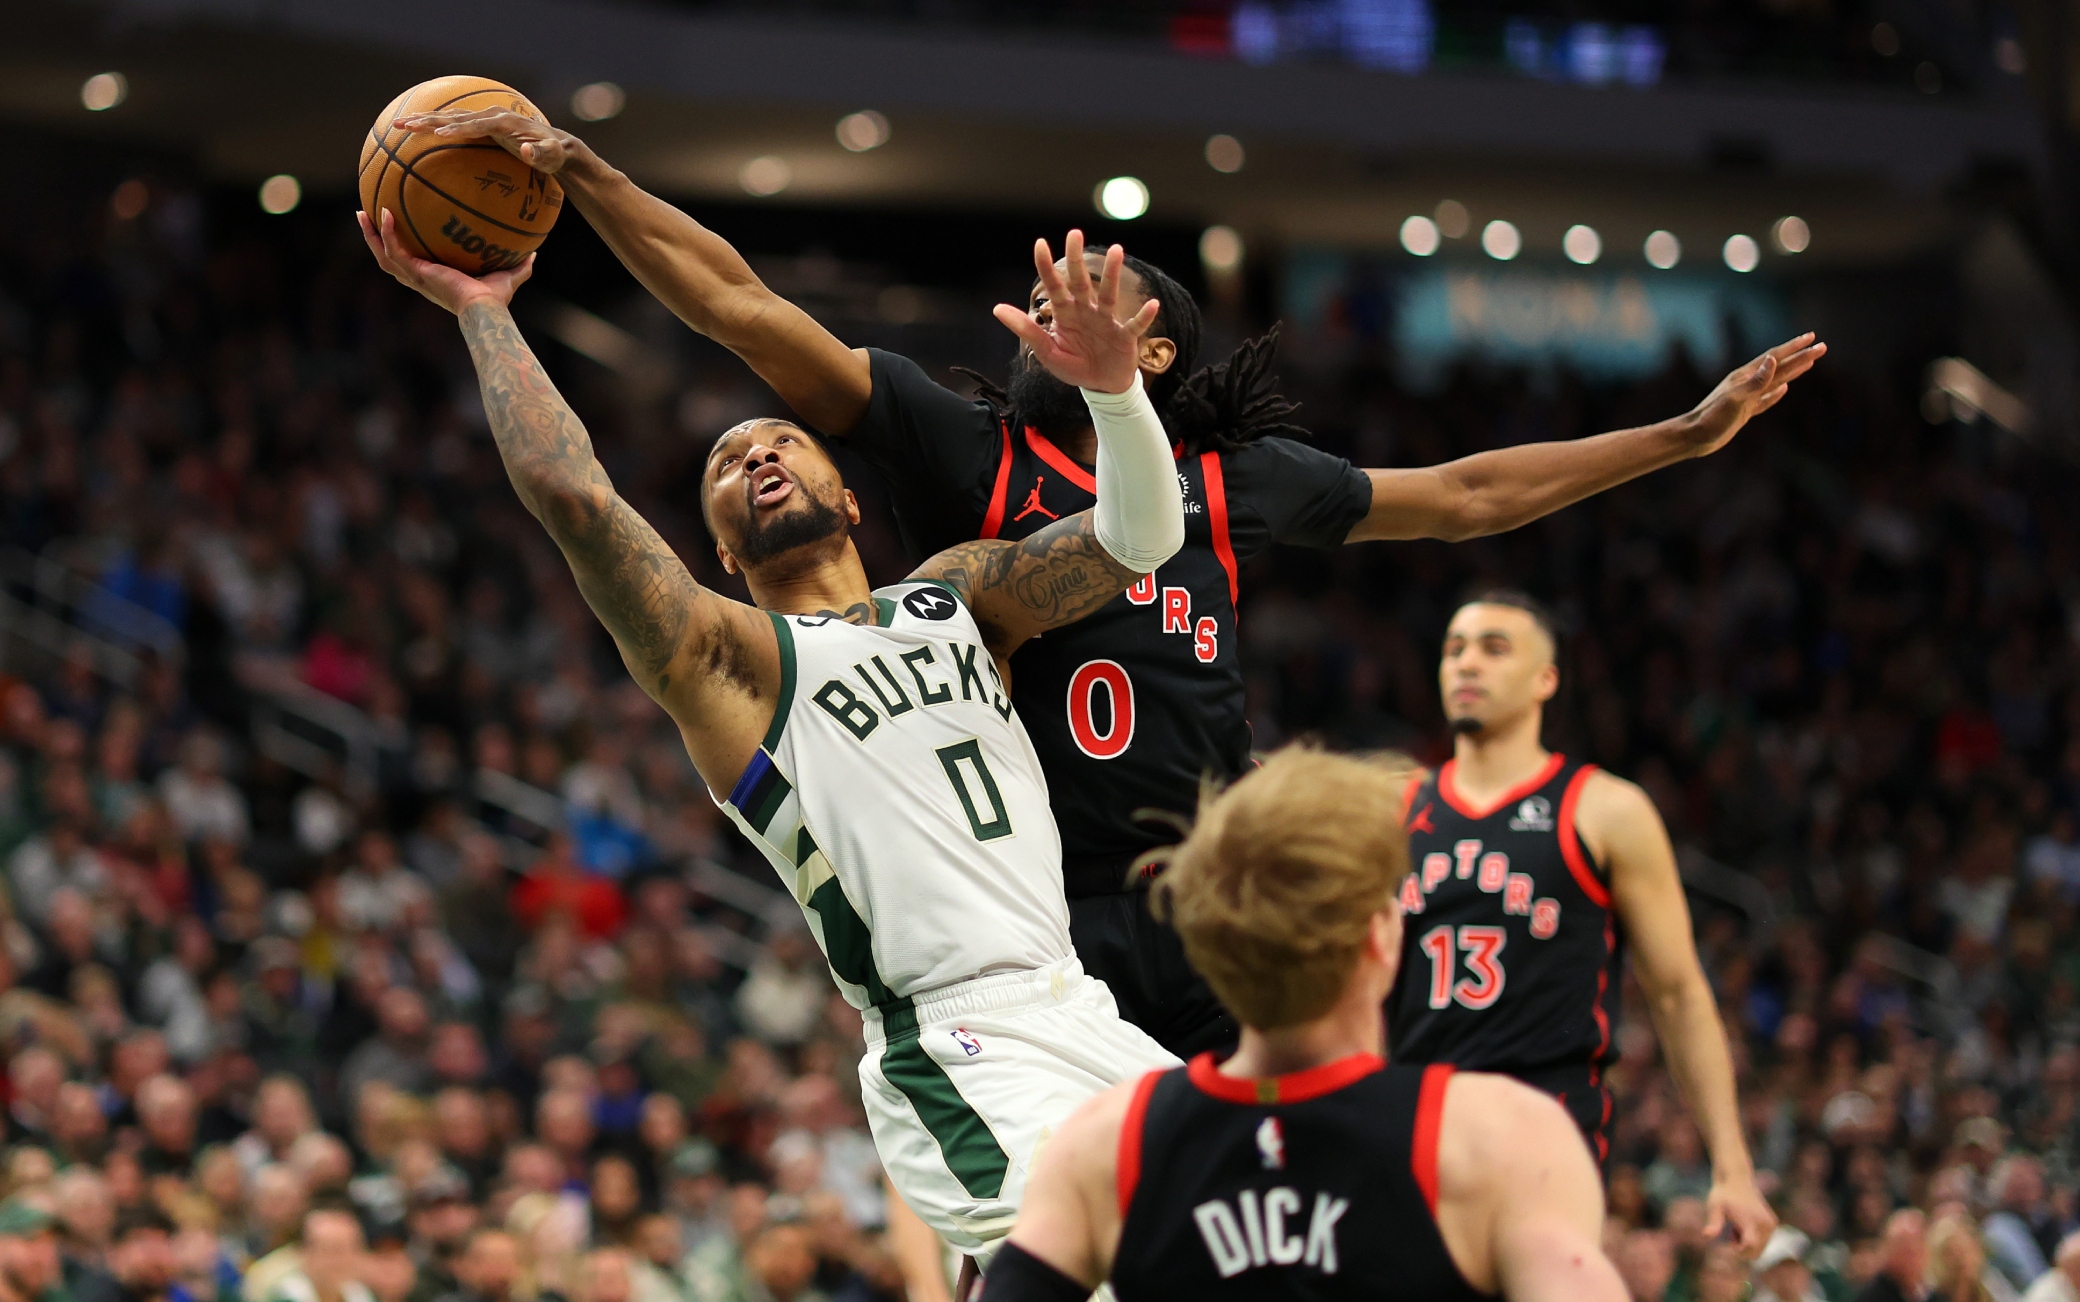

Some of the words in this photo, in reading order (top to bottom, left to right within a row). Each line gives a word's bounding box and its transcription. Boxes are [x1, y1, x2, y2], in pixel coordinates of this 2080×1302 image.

[1184, 501, 1202, 514] ife
[1066, 658, 1136, 760] 0
[931, 734, 1017, 846] 0
[1399, 838, 1562, 941] APTORS
[1419, 923, 1508, 1011] 13
[1192, 1185, 1349, 1279] DICK
